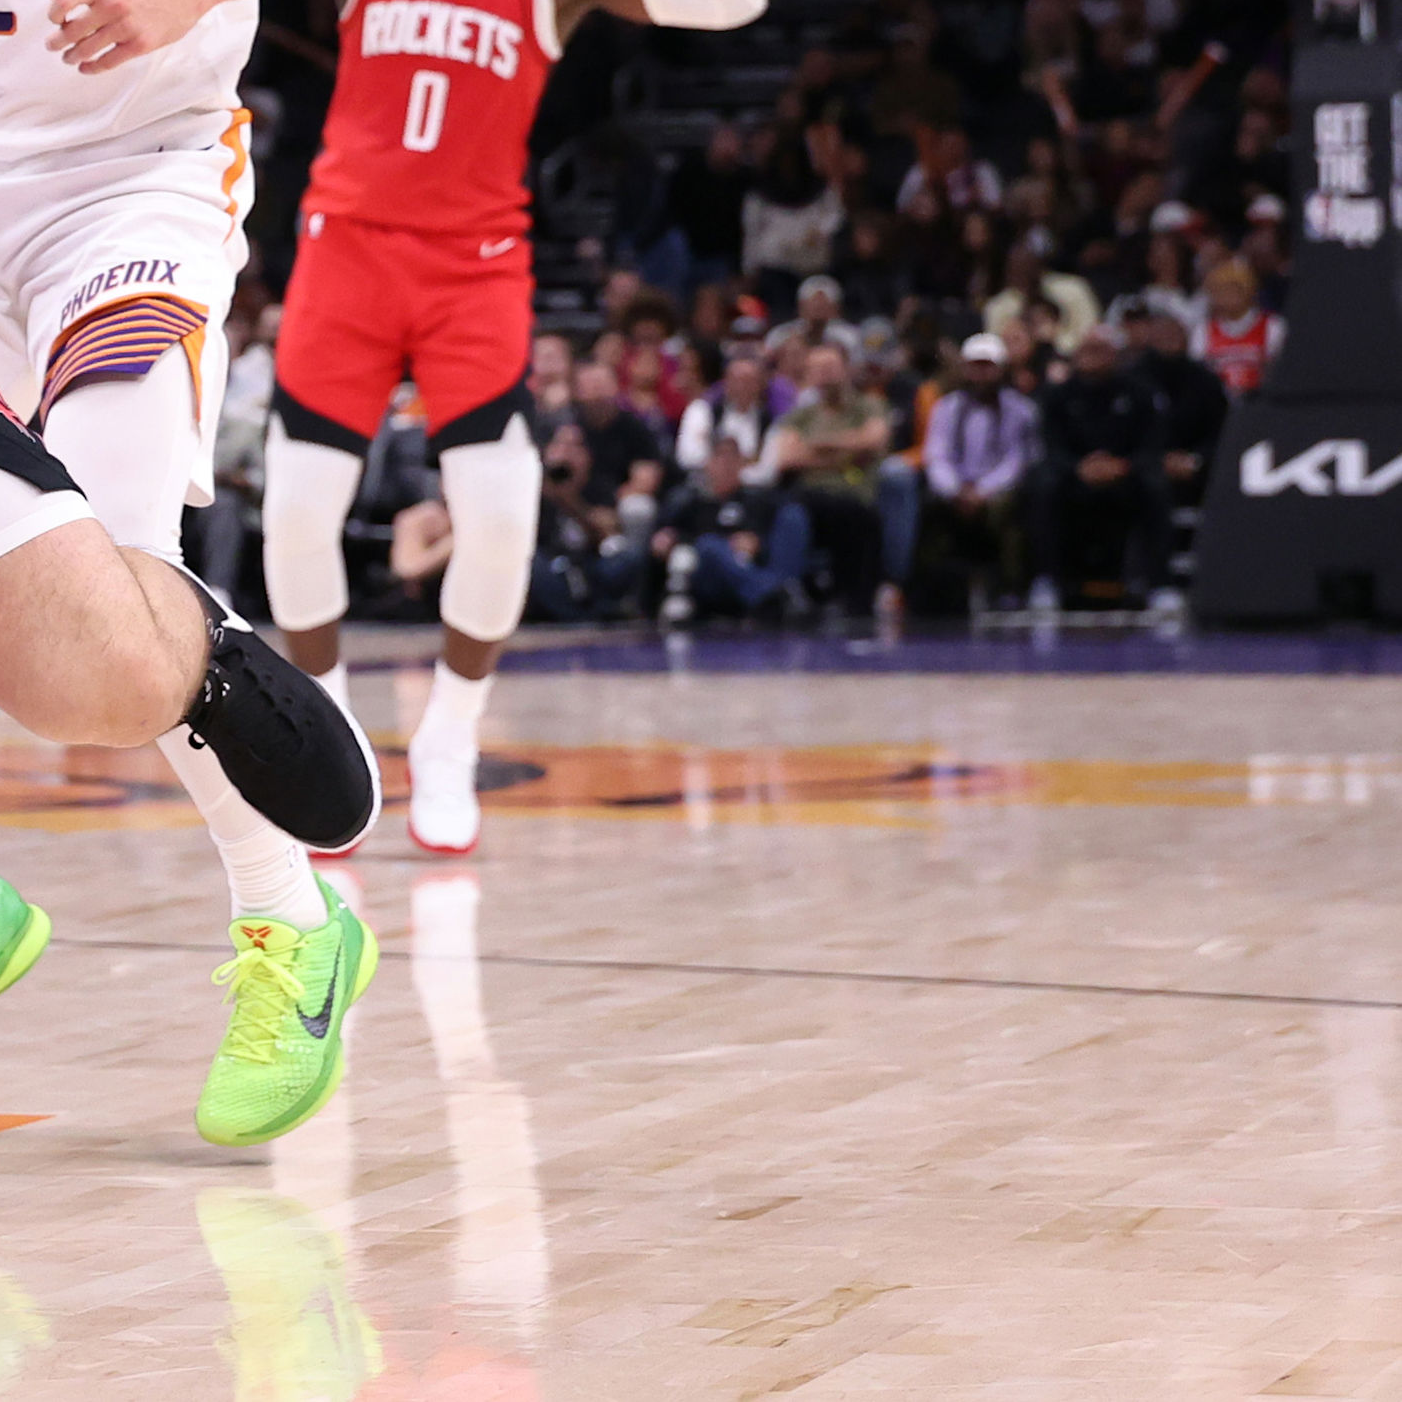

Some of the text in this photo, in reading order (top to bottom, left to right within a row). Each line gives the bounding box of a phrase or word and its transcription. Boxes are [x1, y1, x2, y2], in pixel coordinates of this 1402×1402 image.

[361, 0, 524, 82] ROCKETS
[402, 69, 451, 154] 0
[59, 259, 181, 332] PHOENIX
